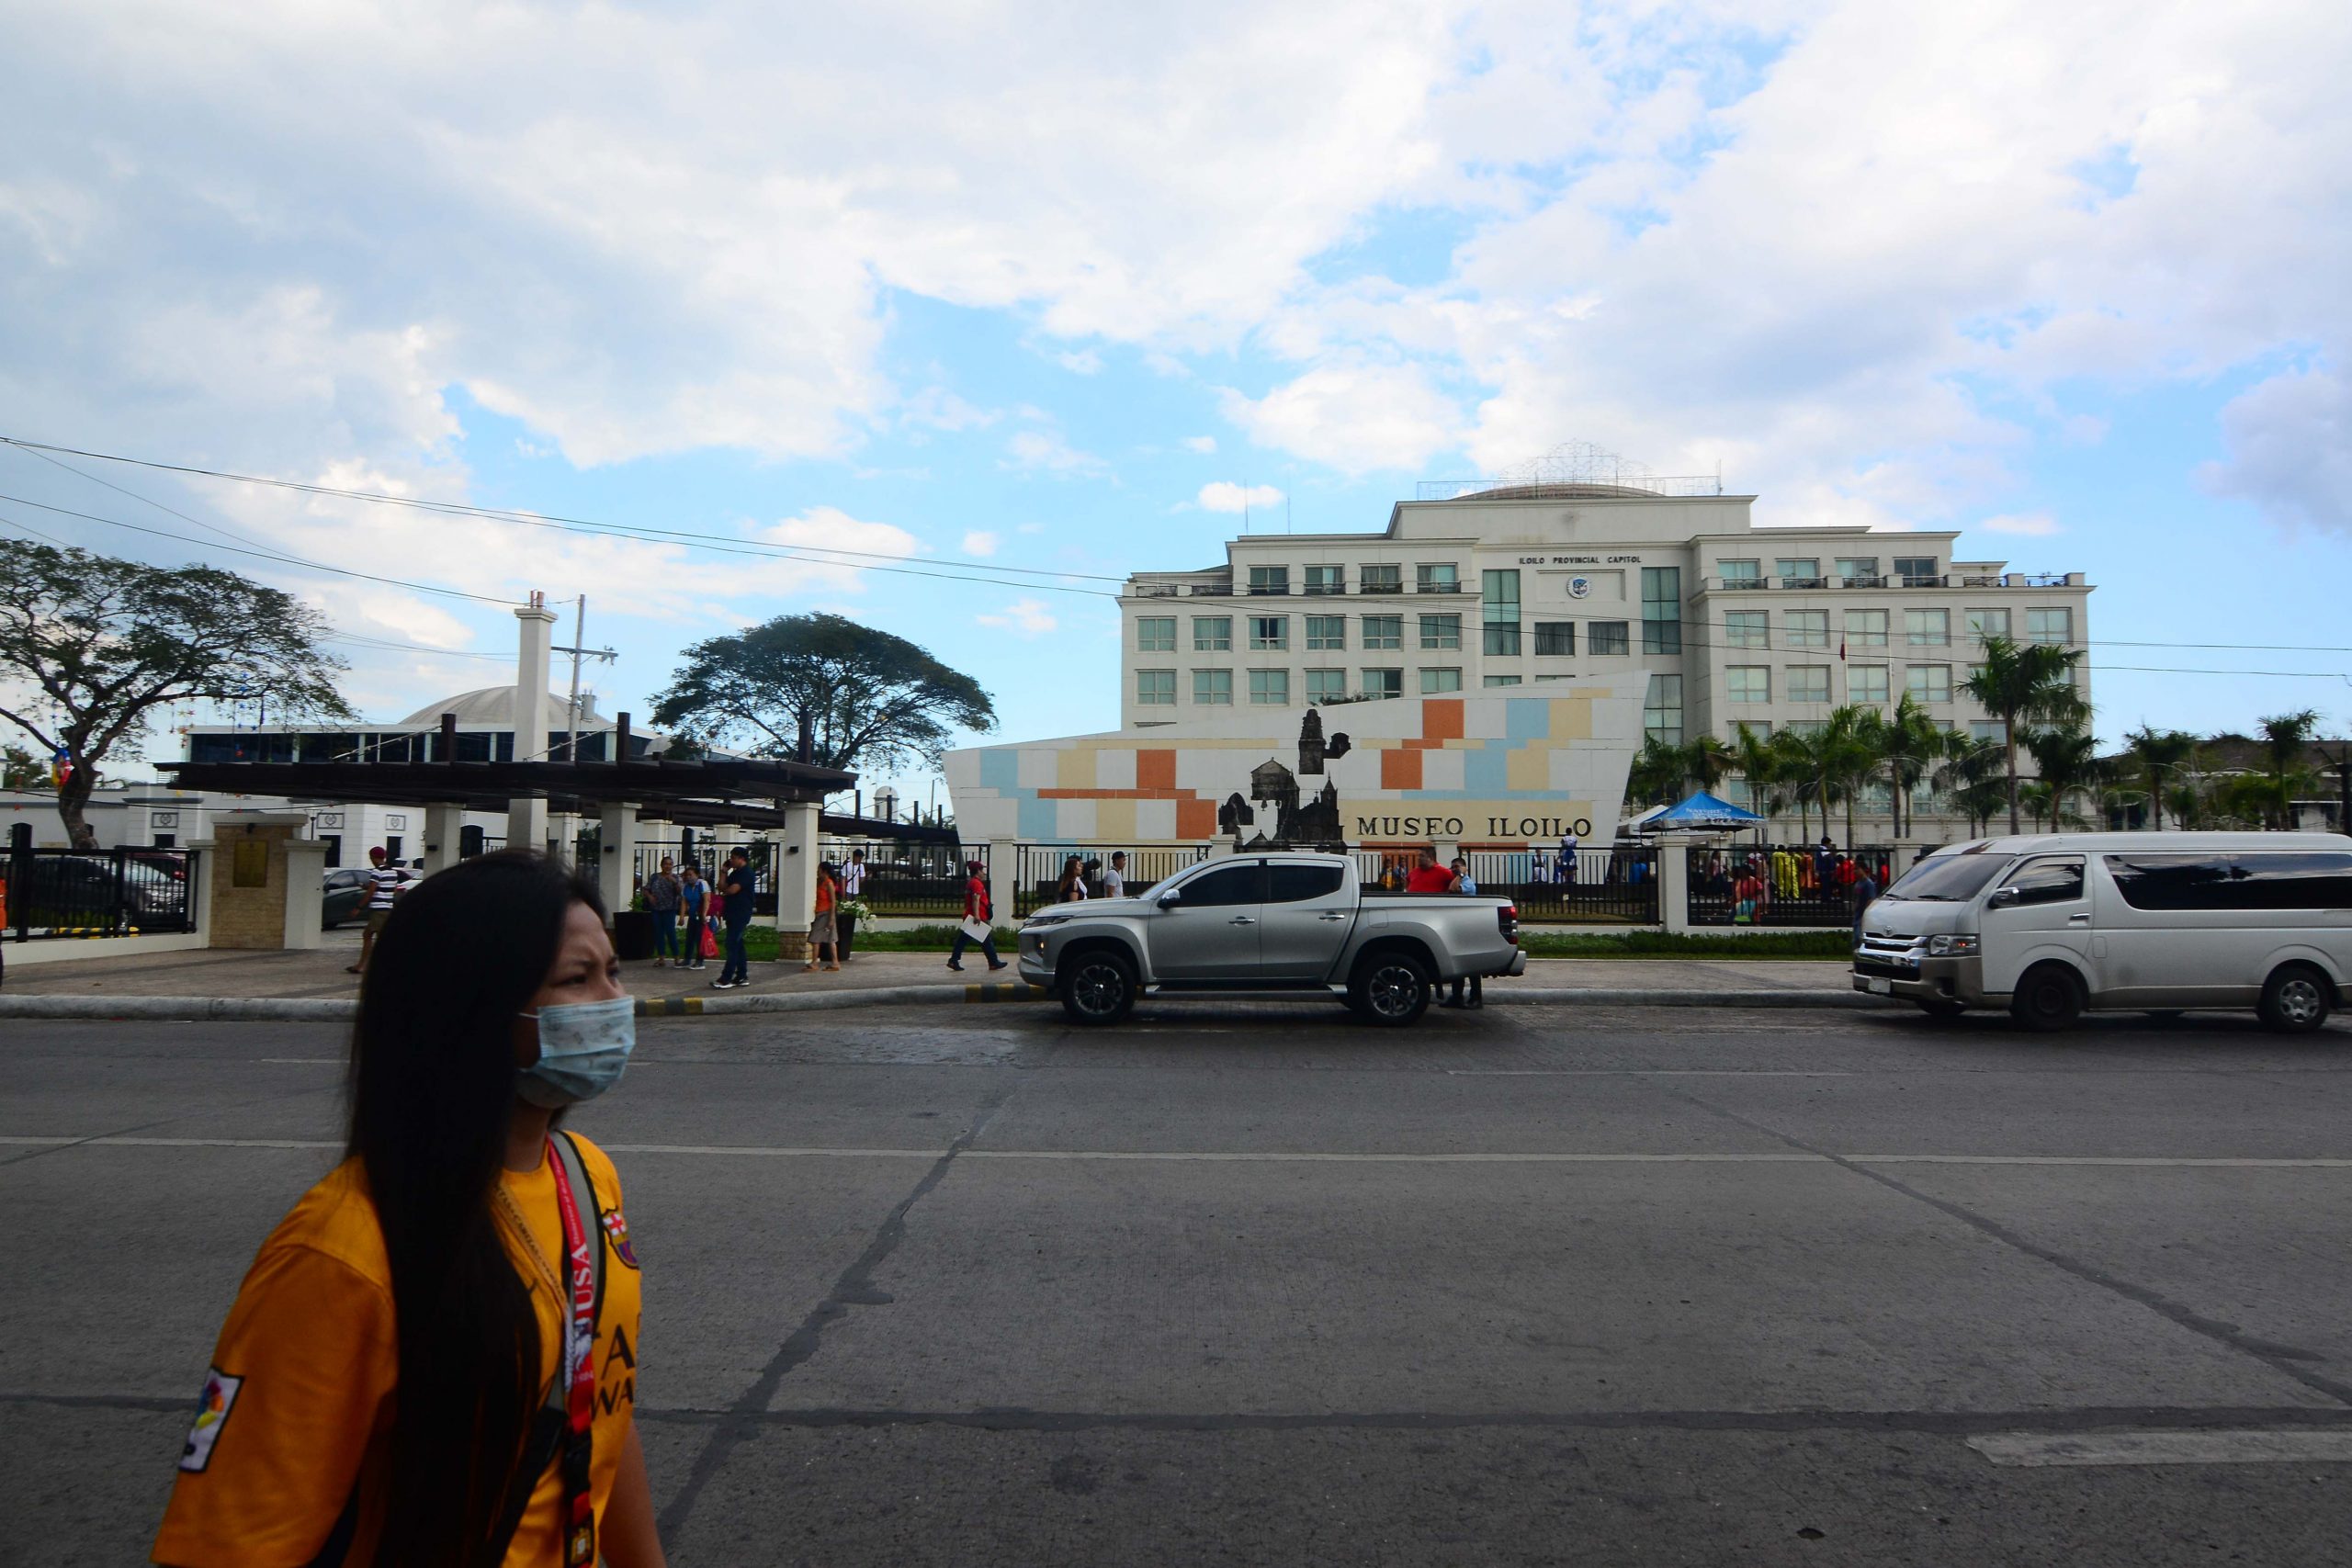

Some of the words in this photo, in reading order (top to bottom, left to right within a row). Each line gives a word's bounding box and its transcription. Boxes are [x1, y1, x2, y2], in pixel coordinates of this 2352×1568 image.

[1519, 557, 1545, 565] ILOILO
[1607, 556, 1642, 564] CAPITOL
[1356, 817, 1464, 836] MUSEO
[1487, 818, 1591, 837] ILOILO
[571, 1243, 594, 1313] USA
